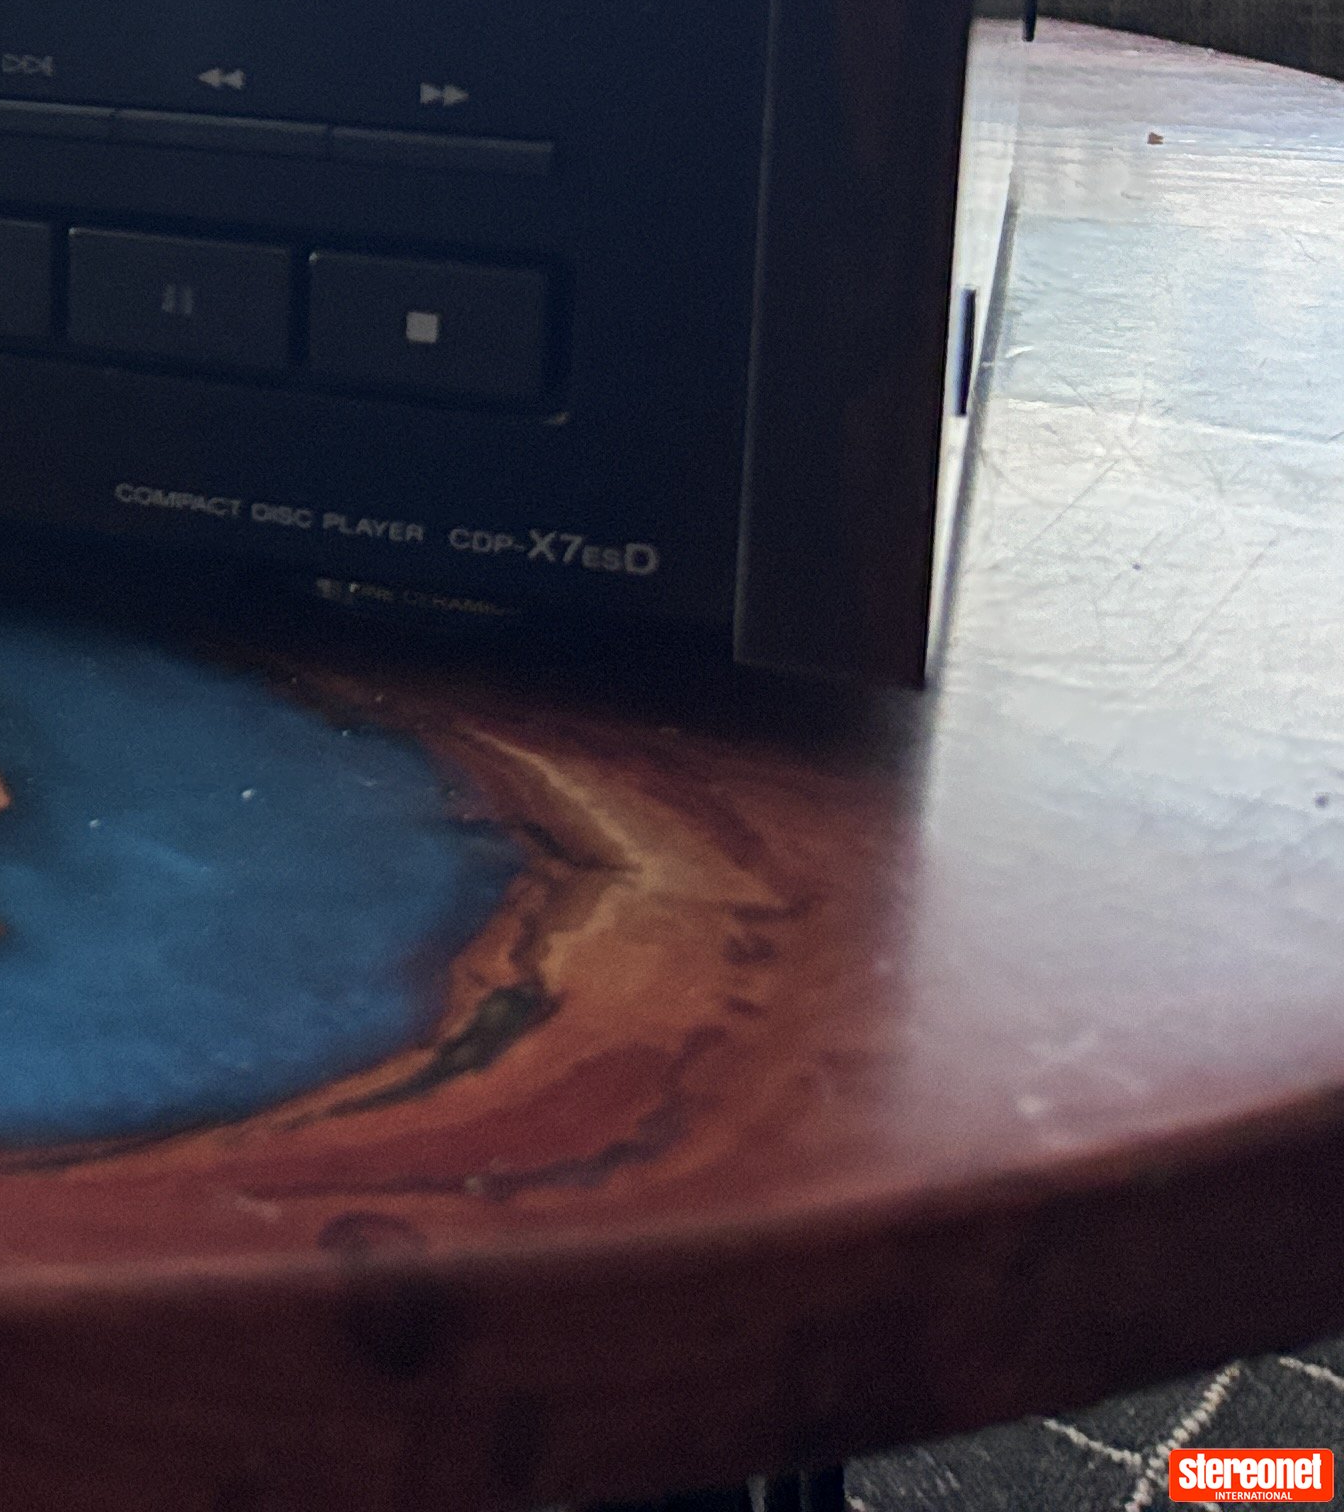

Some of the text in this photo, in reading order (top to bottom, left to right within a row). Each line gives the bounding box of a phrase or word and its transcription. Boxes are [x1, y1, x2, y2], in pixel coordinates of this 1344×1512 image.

[114, 483, 243, 519] COMPACT
[250, 502, 312, 530] DISC
[322, 512, 424, 544] PLAYER
